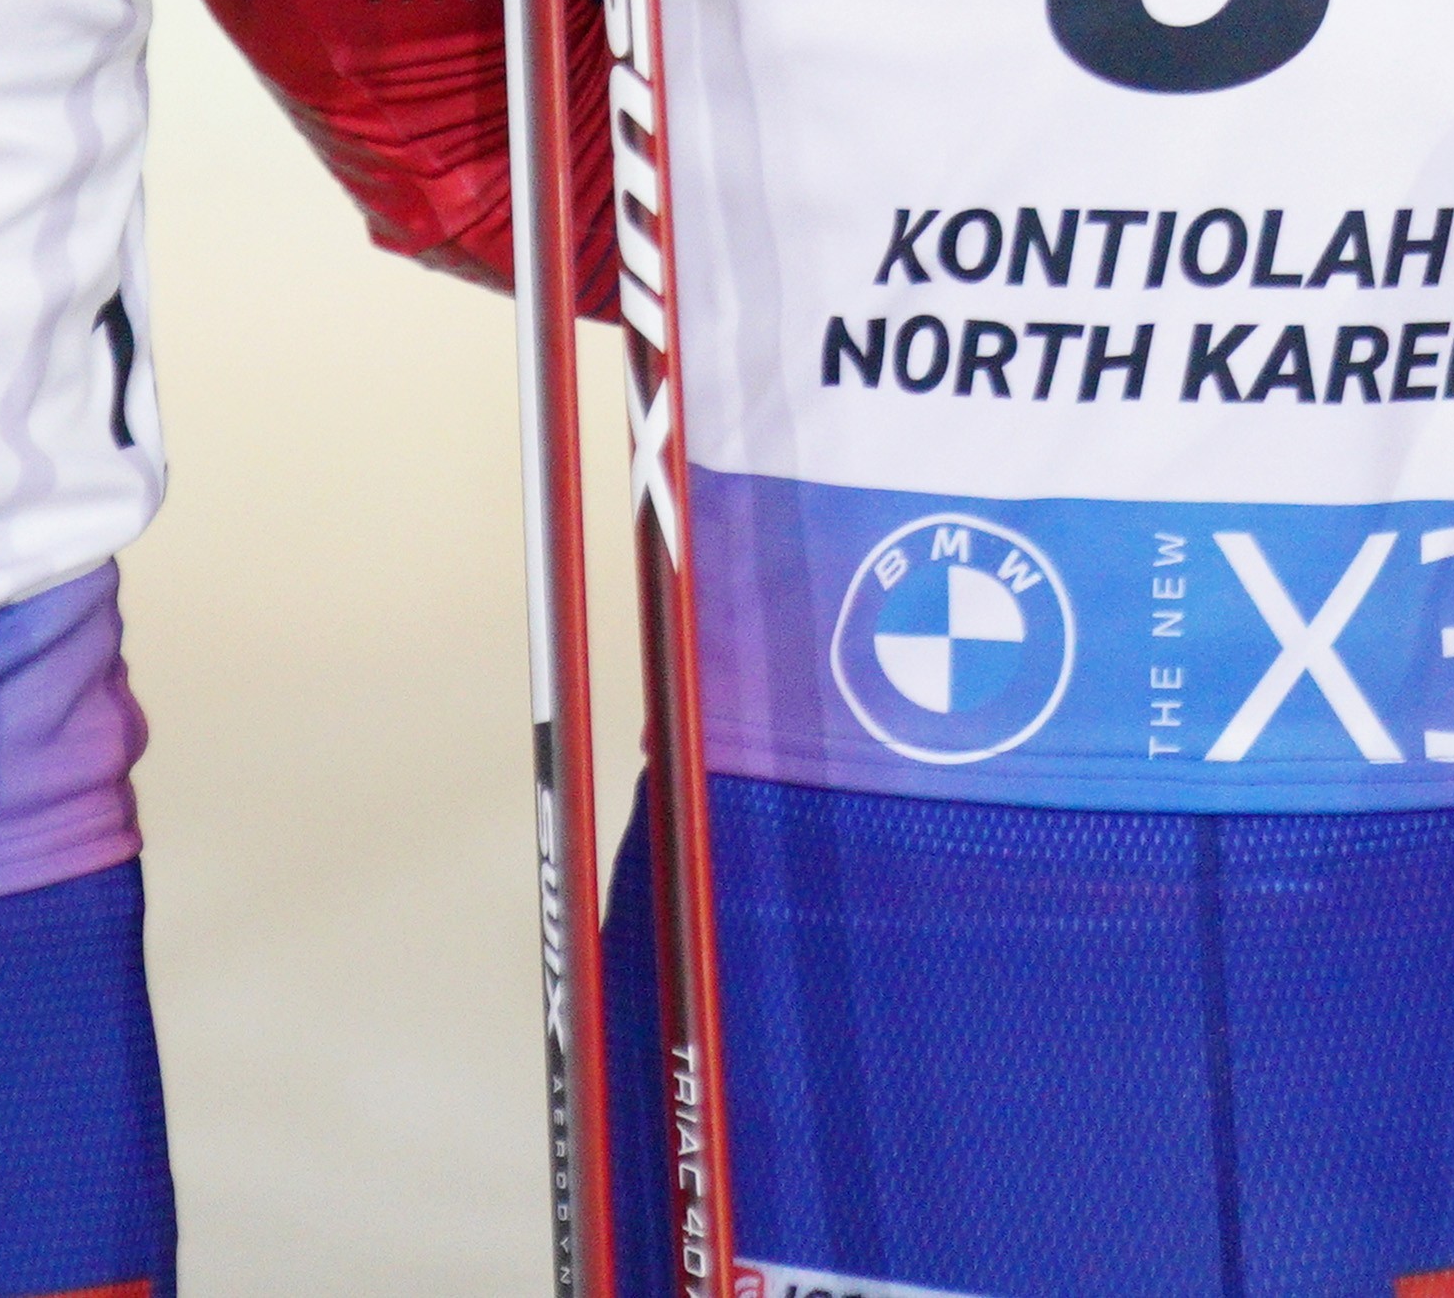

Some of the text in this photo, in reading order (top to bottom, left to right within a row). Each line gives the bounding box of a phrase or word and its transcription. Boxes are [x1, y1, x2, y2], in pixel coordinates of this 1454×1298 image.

[819, 313, 1154, 403] NORTH
[873, 525, 1045, 595] BMW
[1148, 531, 1190, 760] THE NEW
[670, 1043, 705, 1198] TRIAC
